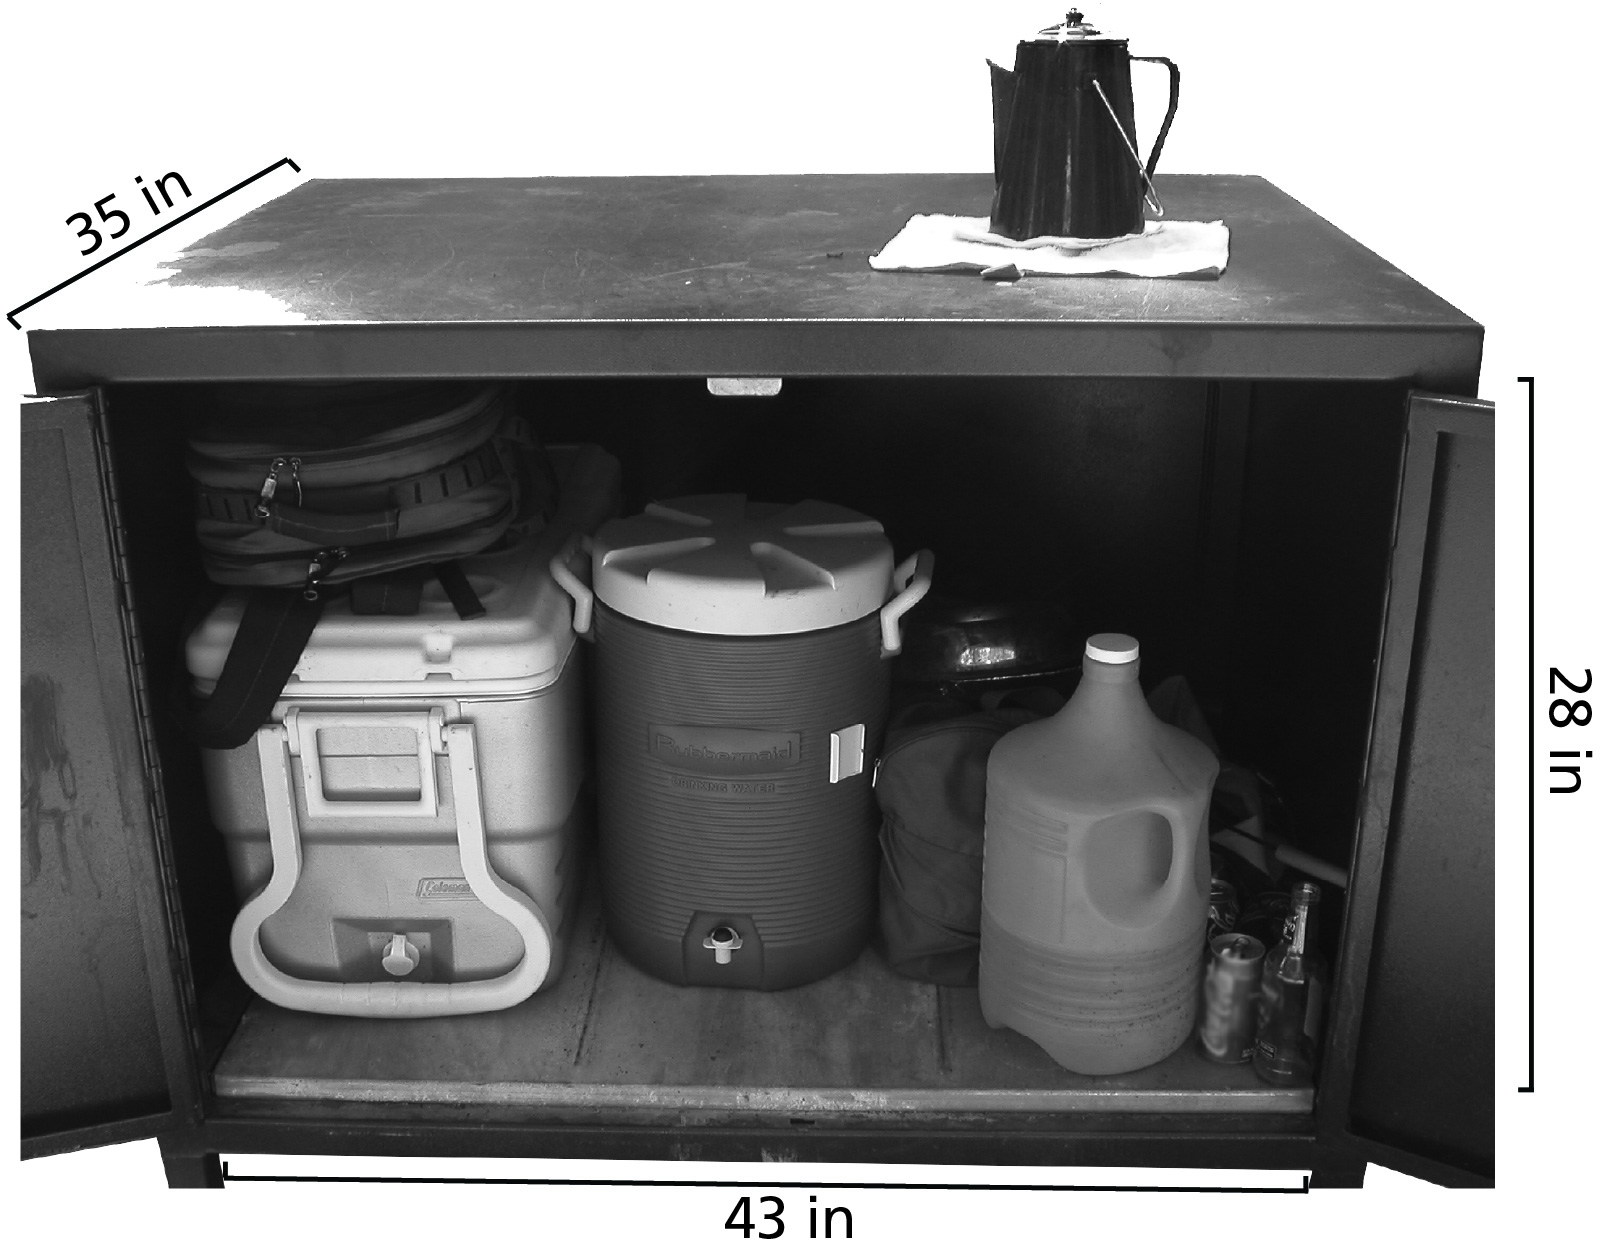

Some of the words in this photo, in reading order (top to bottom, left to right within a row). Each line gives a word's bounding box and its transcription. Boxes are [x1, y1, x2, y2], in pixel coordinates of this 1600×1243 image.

[655, 732, 792, 761] Rubbermaid
[671, 776, 728, 792] DRINKING
[732, 782, 776, 793] WATER
